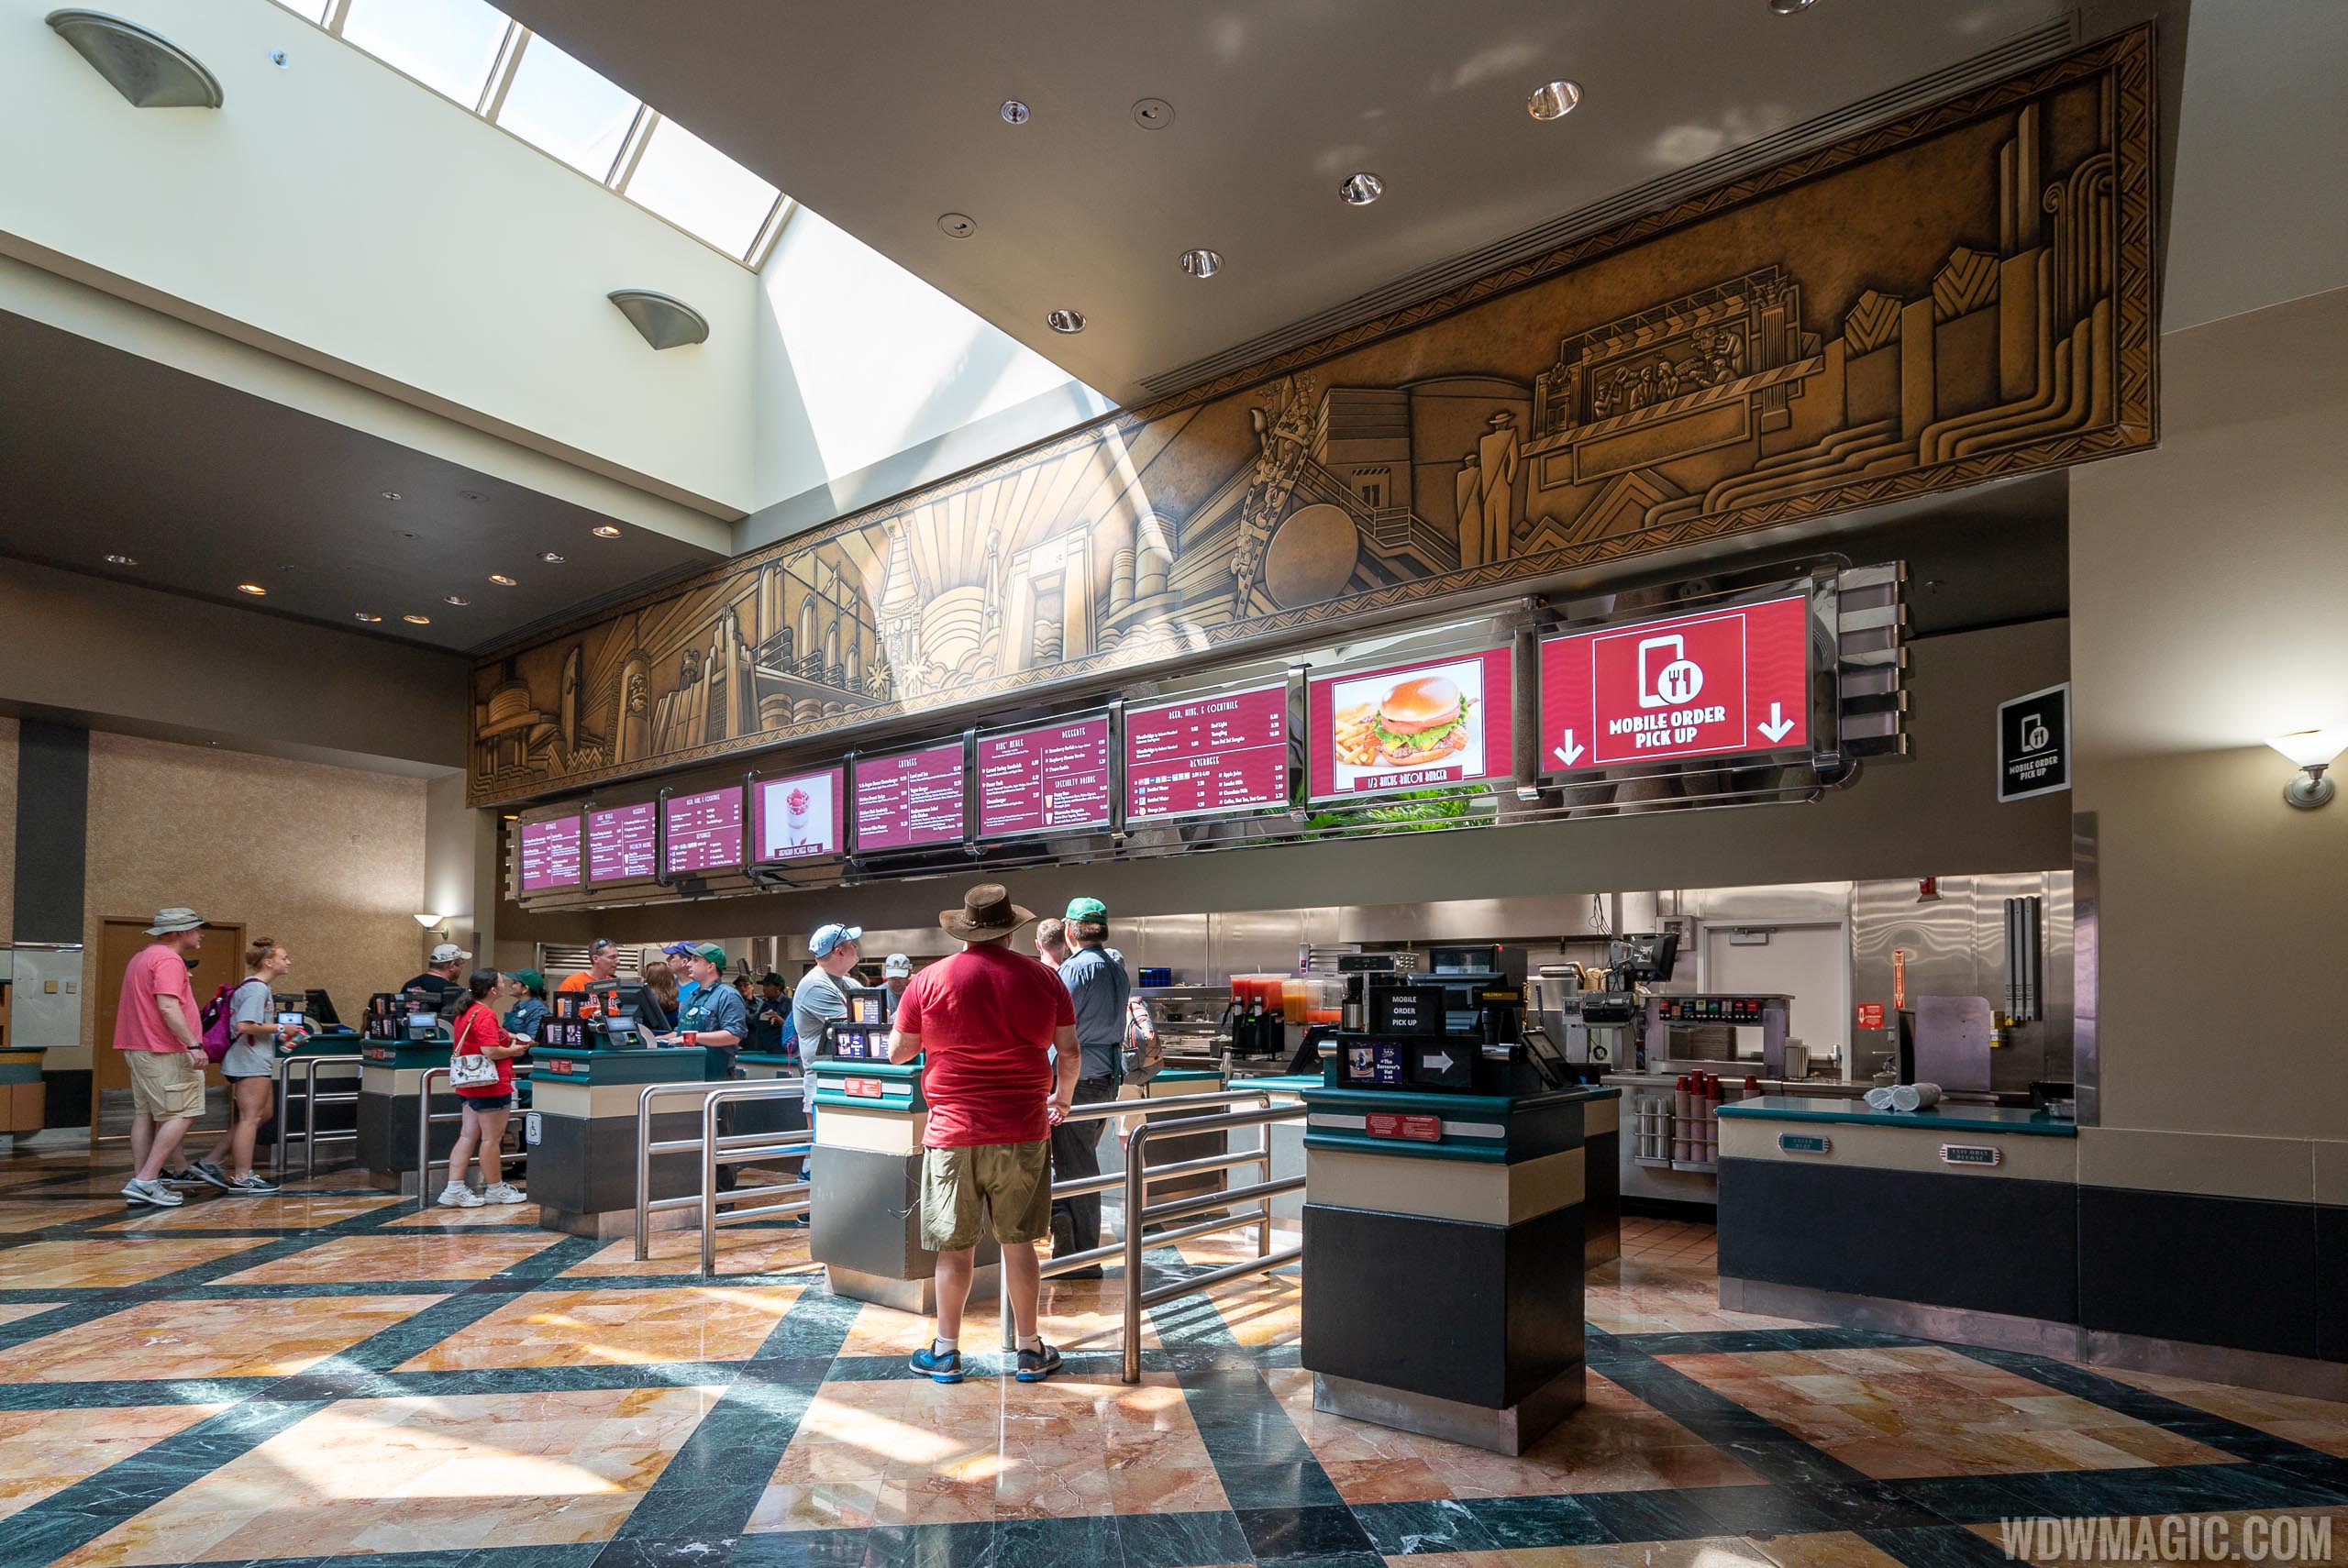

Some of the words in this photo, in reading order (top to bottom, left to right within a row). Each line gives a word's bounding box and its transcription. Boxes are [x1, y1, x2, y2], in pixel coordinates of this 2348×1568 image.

[1207, 701, 1238, 713] COCKTAILS
[1609, 712, 1667, 735] MOBILE
[1671, 705, 1726, 728] ORDER
[1062, 727, 1086, 739] DESSERTS
[1635, 728, 1671, 749] PICK
[1674, 726, 1698, 744] UP
[1190, 756, 1219, 767] BEVERAGES
[2009, 761, 2034, 775] MOBILE
[2035, 756, 2058, 768] ORDER
[1368, 778, 1378, 789] 1/3
[1379, 775, 1397, 787] ANGUS
[1400, 772, 1423, 785] BACON
[1425, 769, 1447, 781] BURGER
[2020, 770, 2036, 780] PICK
[2036, 767, 2047, 777] UP
